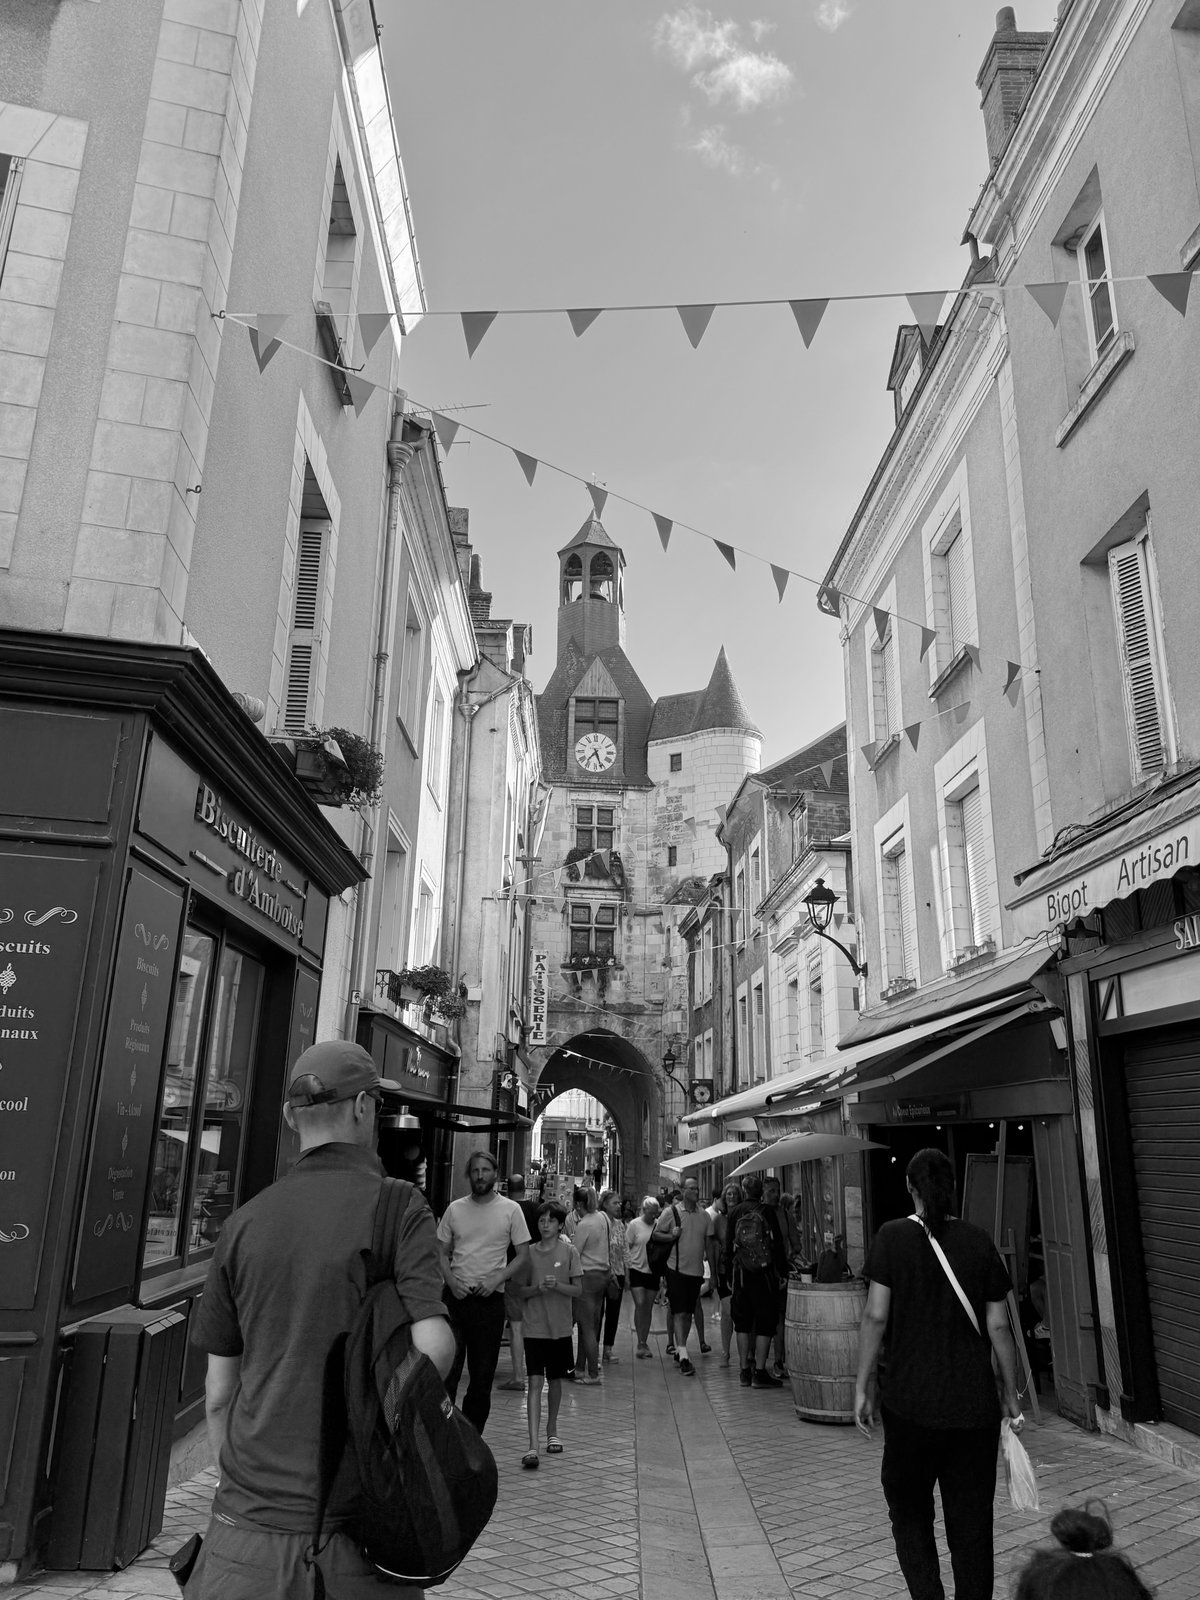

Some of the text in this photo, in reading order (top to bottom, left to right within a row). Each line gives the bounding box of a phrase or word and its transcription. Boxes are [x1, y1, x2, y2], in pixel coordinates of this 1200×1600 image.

[197, 783, 284, 883] Biscuiterie
[1047, 836, 1189, 923] Bigot Artisan
[136, 957, 159, 976] Biscuits
[533, 954, 547, 1040] PATISSERIE
[1, 1028, 39, 1040] naux
